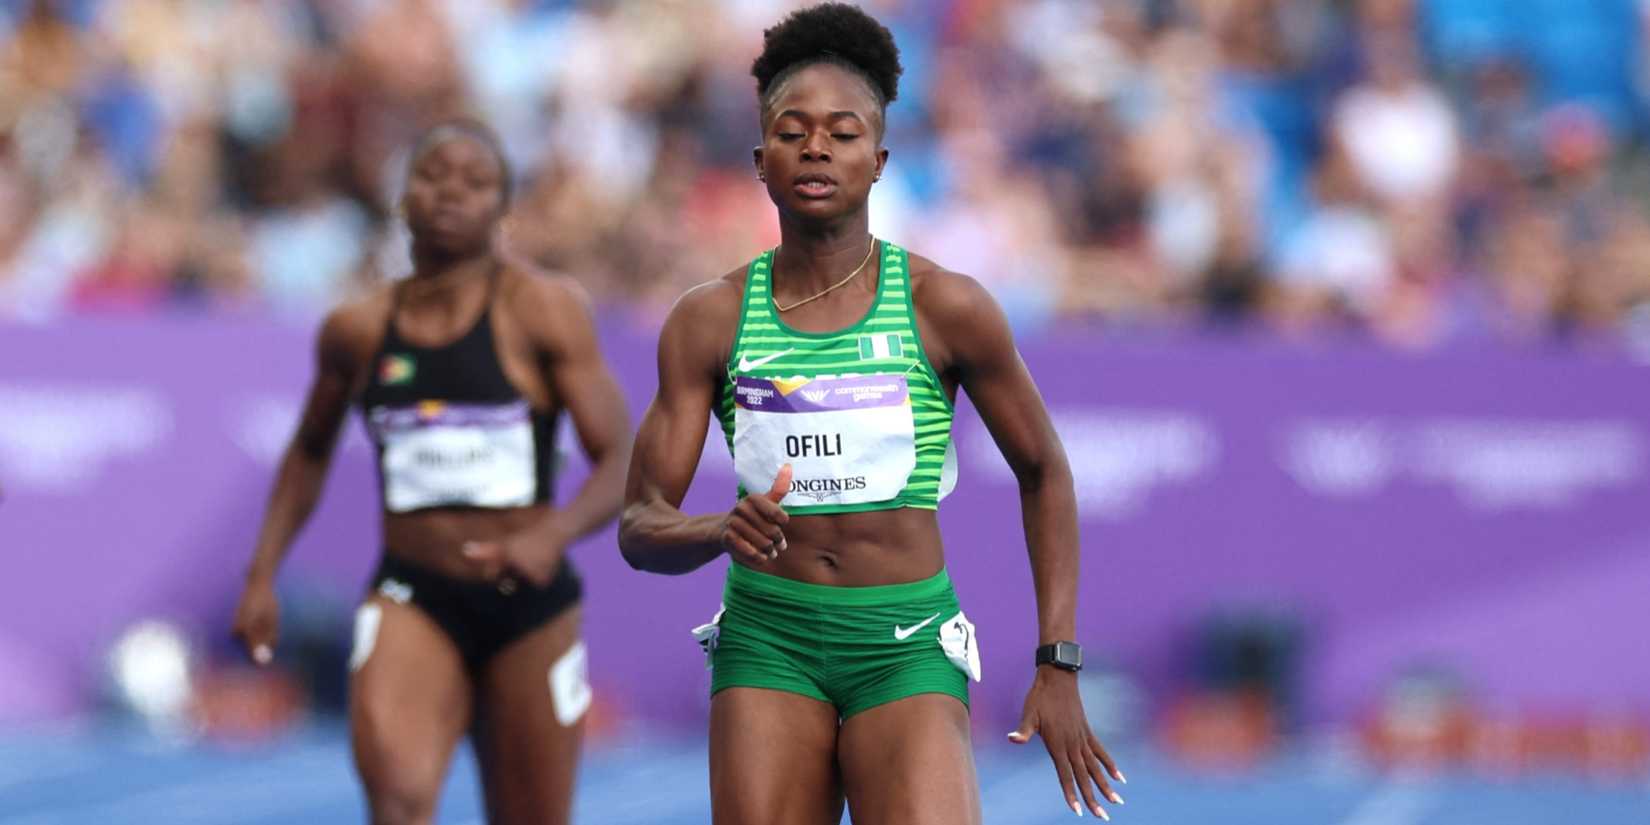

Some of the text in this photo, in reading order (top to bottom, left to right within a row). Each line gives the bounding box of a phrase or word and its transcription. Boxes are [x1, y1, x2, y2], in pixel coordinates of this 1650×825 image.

[736, 386, 774, 398] BIRMINGHAM
[746, 395, 763, 405] 2022
[785, 433, 842, 457] OFILI
[788, 476, 866, 492] ONGINES
